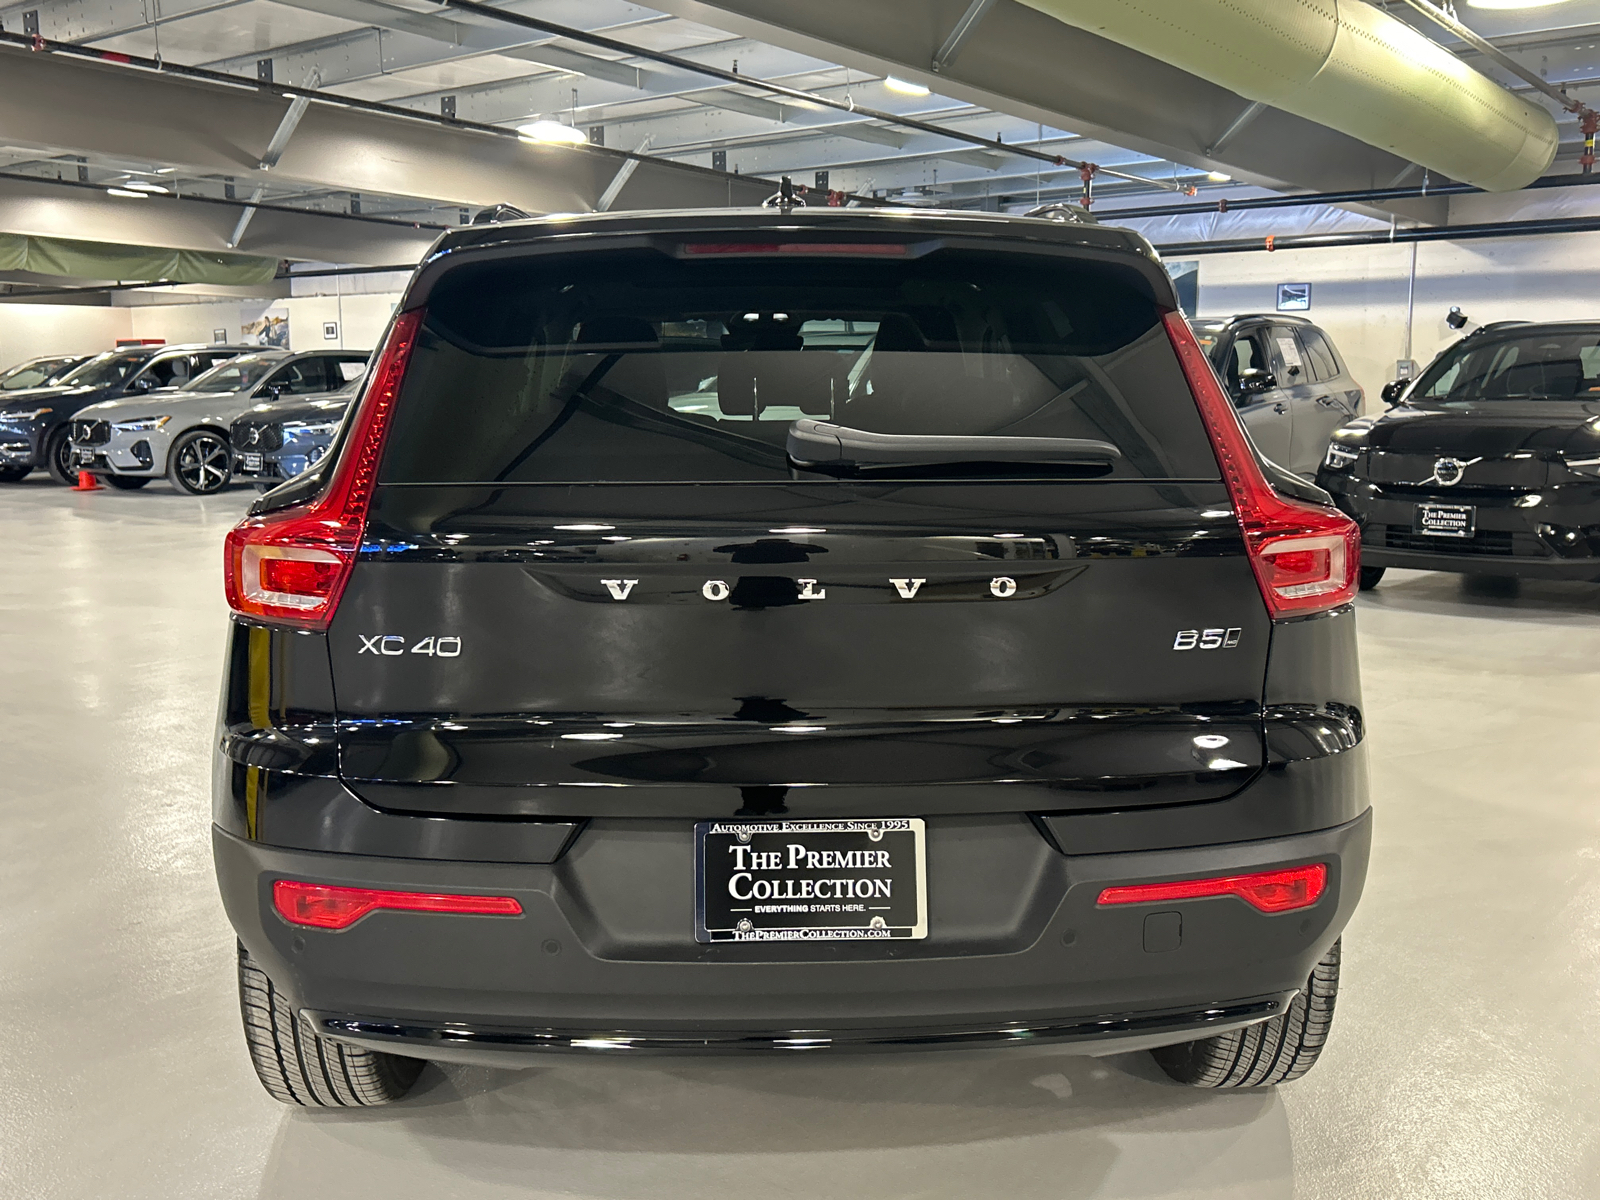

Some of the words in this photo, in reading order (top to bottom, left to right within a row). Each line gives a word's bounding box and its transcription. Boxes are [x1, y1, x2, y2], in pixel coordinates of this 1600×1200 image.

[1422, 510, 1437, 518] THE
[1438, 510, 1466, 519] PREMIER
[1422, 517, 1467, 527] COLLECTION
[600, 576, 1017, 600] VOLVO
[712, 823, 780, 833] AUTOMOTIVE
[782, 822, 845, 832] EXCELLENCE
[846, 821, 878, 831] SINCE
[881, 820, 908, 830] 1995
[729, 845, 782, 871] THE
[786, 844, 892, 869] PREMIER
[728, 873, 892, 900] COLLECTION
[754, 905, 809, 914] EVERYTHING
[810, 904, 842, 913] STARTS
[842, 904, 866, 912] HERE.
